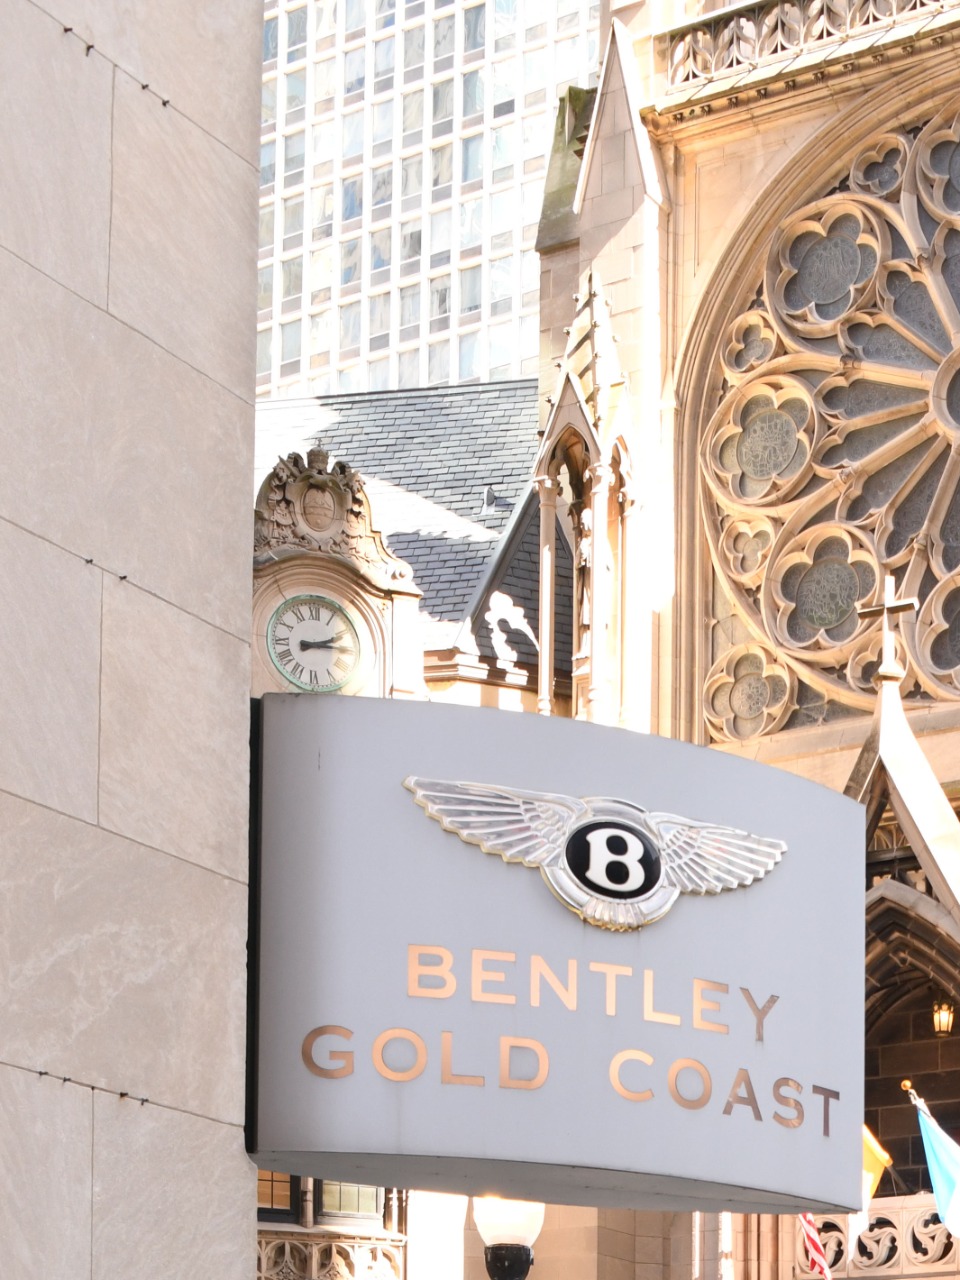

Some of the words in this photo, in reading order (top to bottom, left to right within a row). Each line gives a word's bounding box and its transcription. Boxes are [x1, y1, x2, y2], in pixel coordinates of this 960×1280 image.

[279, 619, 294, 633] X
[291, 607, 306, 624] XI
[308, 606, 320, 621] XII
[585, 826, 646, 894] B
[407, 943, 780, 1042] BENTLEY
[301, 1024, 550, 1090] GOLD
[608, 1048, 841, 1137] COAST
